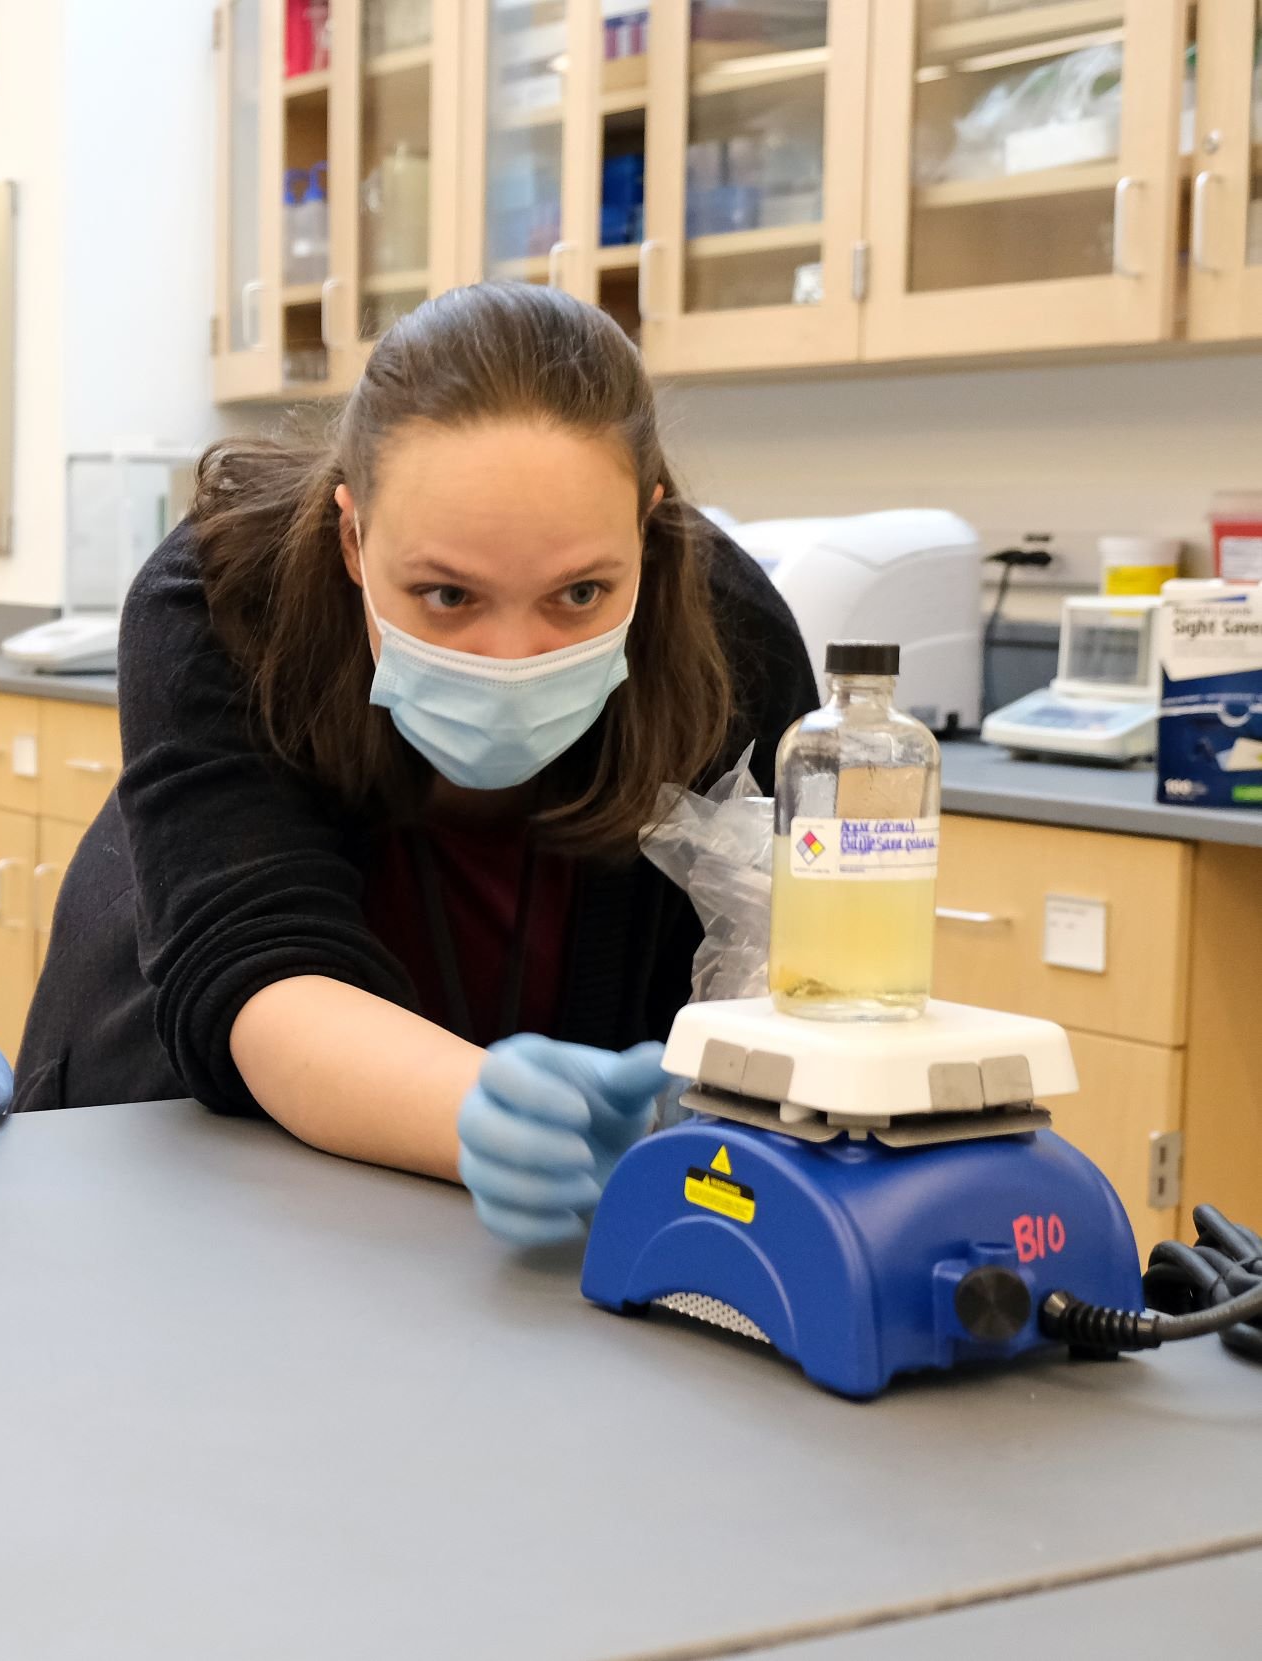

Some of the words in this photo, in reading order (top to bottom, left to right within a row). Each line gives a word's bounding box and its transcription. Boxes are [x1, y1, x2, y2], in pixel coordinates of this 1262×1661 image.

[1173, 619, 1215, 640] Sight
[1223, 619, 1262, 634] Save
[1012, 1212, 1066, 1264] BIO
